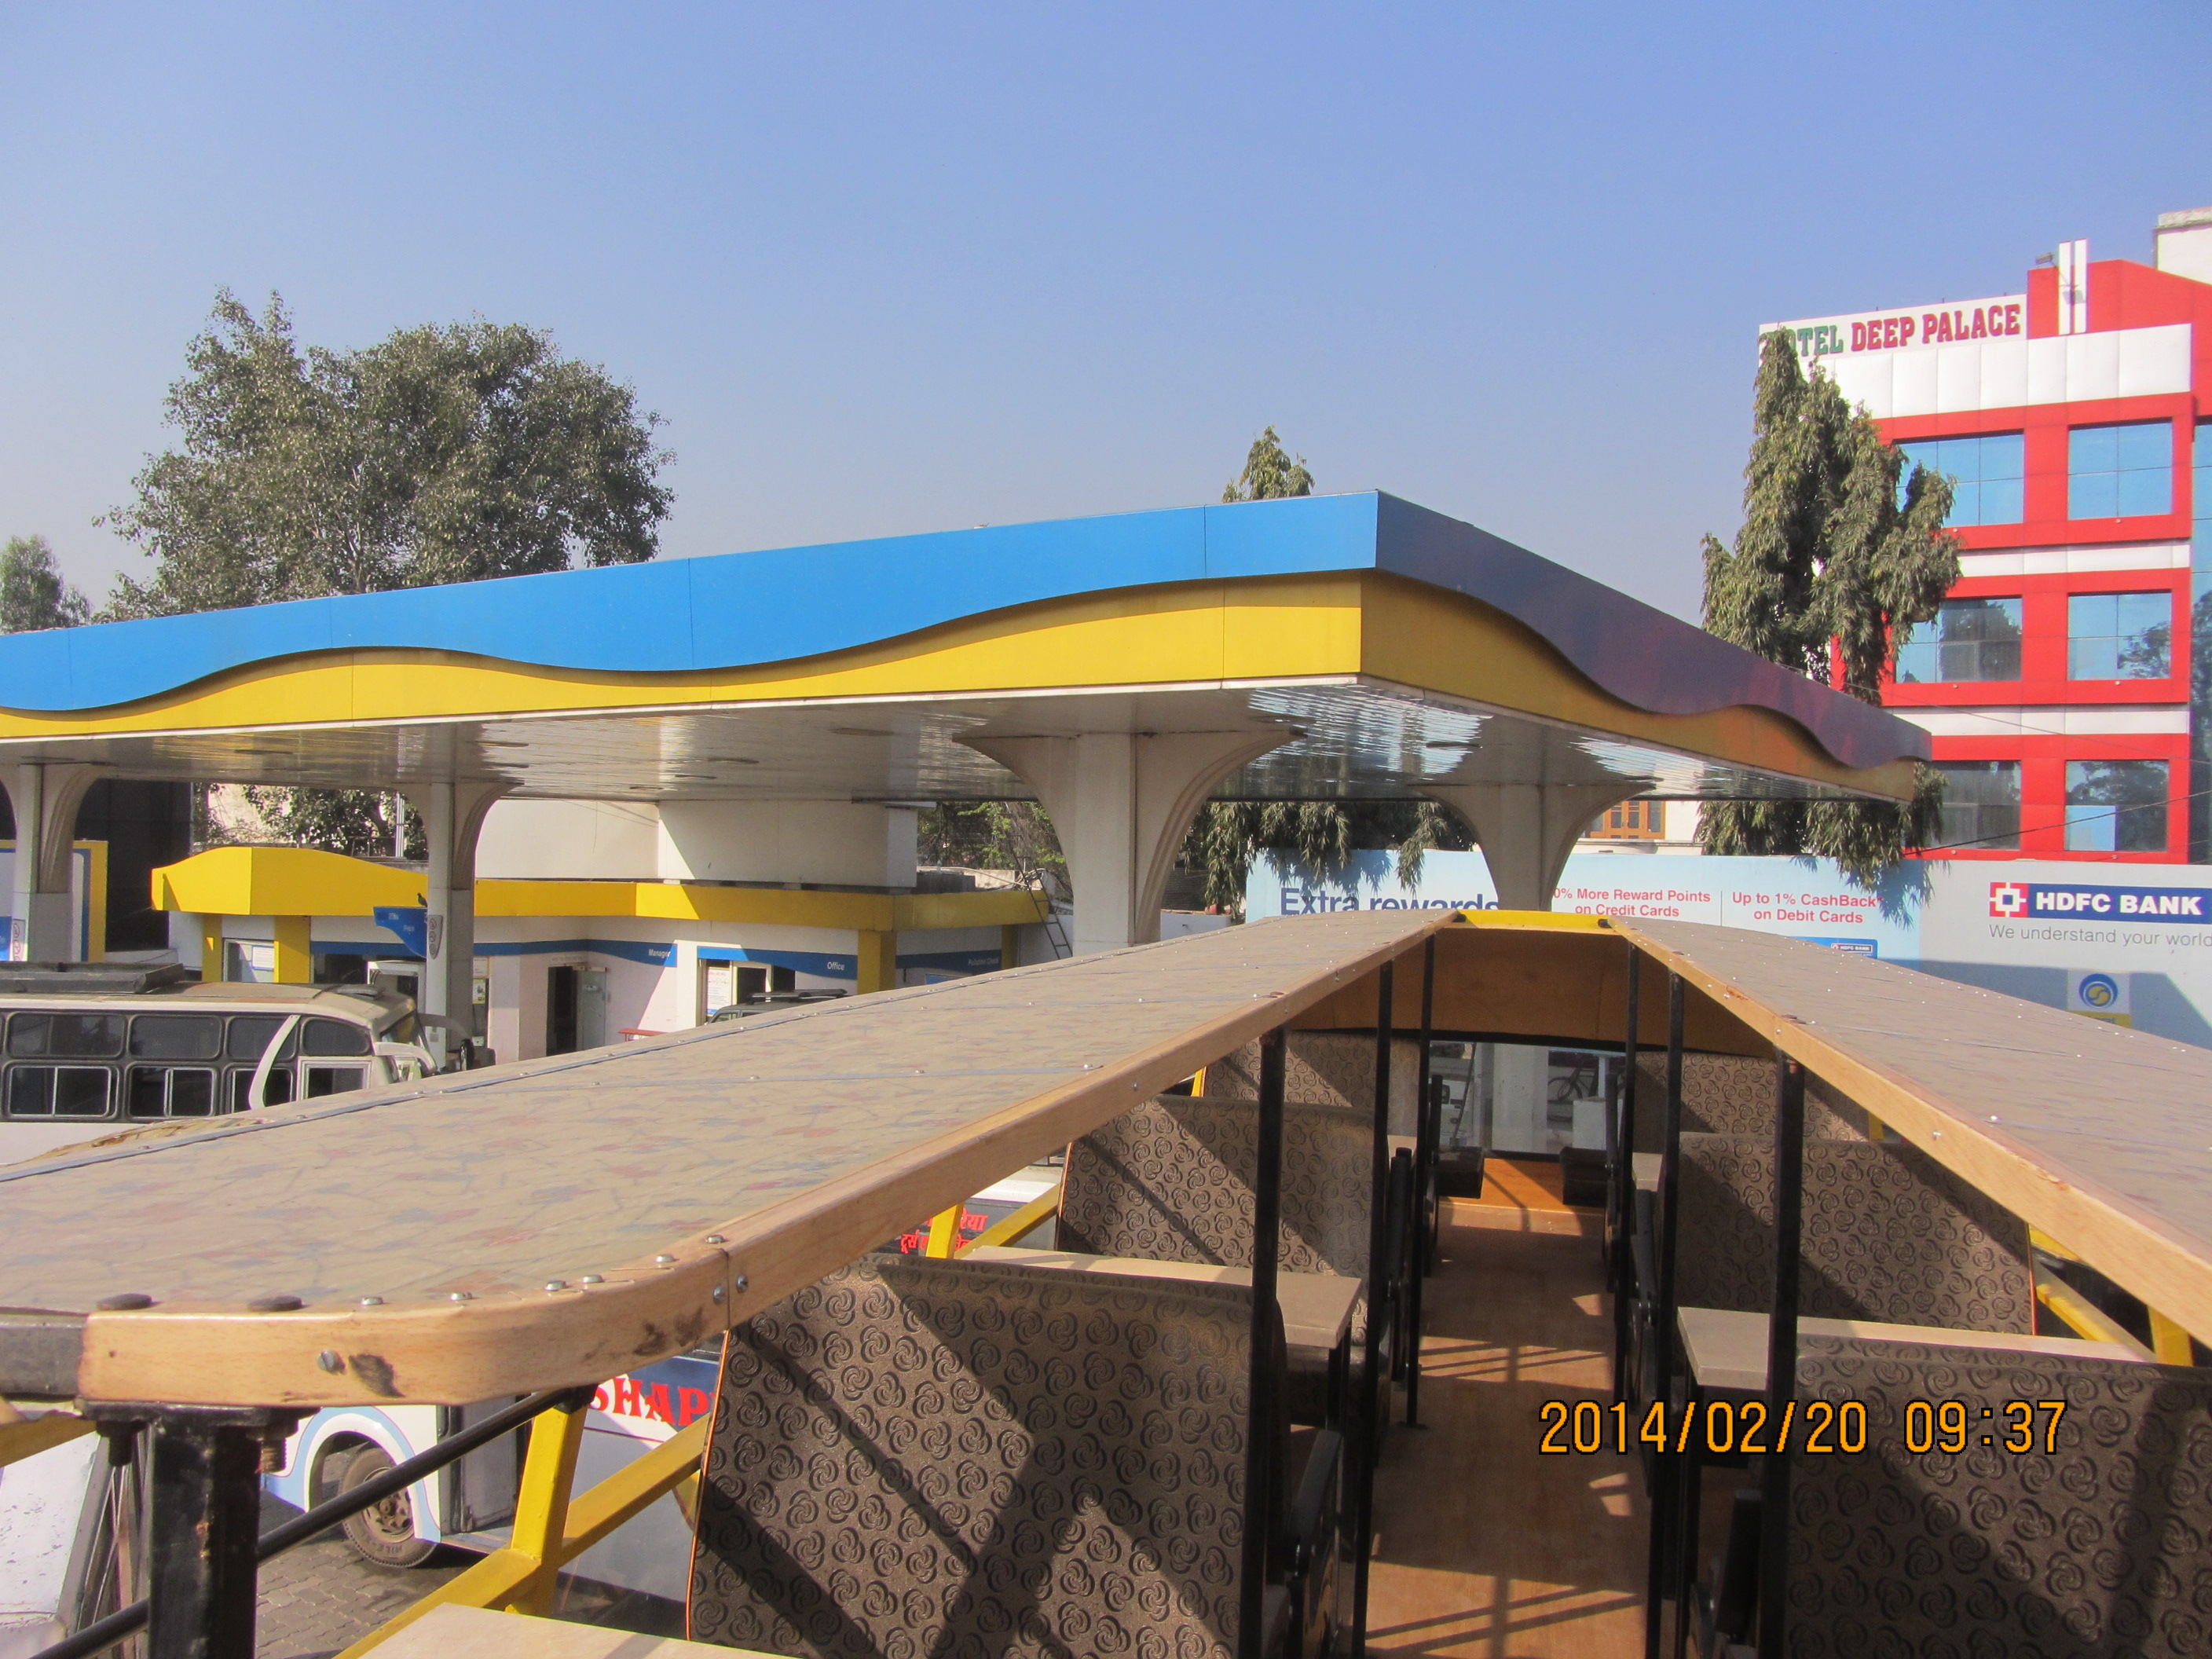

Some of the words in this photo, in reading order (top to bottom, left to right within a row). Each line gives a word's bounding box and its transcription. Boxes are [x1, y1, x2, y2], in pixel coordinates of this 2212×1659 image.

[1766, 324, 1844, 357] TEL
[1851, 317, 1915, 352] DEEP
[1922, 303, 2020, 344] PALACE
[1280, 887, 1359, 915] Extra
[1553, 888, 1573, 899] 0%
[1577, 888, 1609, 899] More
[1613, 889, 1662, 901] Reward
[1668, 890, 1711, 902] Points
[1732, 892, 1751, 906] Up
[1756, 893, 1770, 903] to
[1774, 893, 1796, 905] 1%
[1575, 906, 1591, 914] on
[1596, 904, 1635, 916] Credit
[1640, 905, 1679, 917] Cards
[2036, 892, 2111, 913] HDFC
[2119, 895, 2203, 915] BANK
[1754, 910, 1771, 920] on
[1777, 909, 1815, 921] Debit
[1819, 910, 1863, 923] Cards
[1989, 925, 2014, 939] We
[2020, 927, 2116, 943] understand
[2122, 932, 2159, 947] your
[648, 948, 672, 959] Manager
[827, 961, 845, 971] Office
[590, 1377, 715, 1426] HAP
